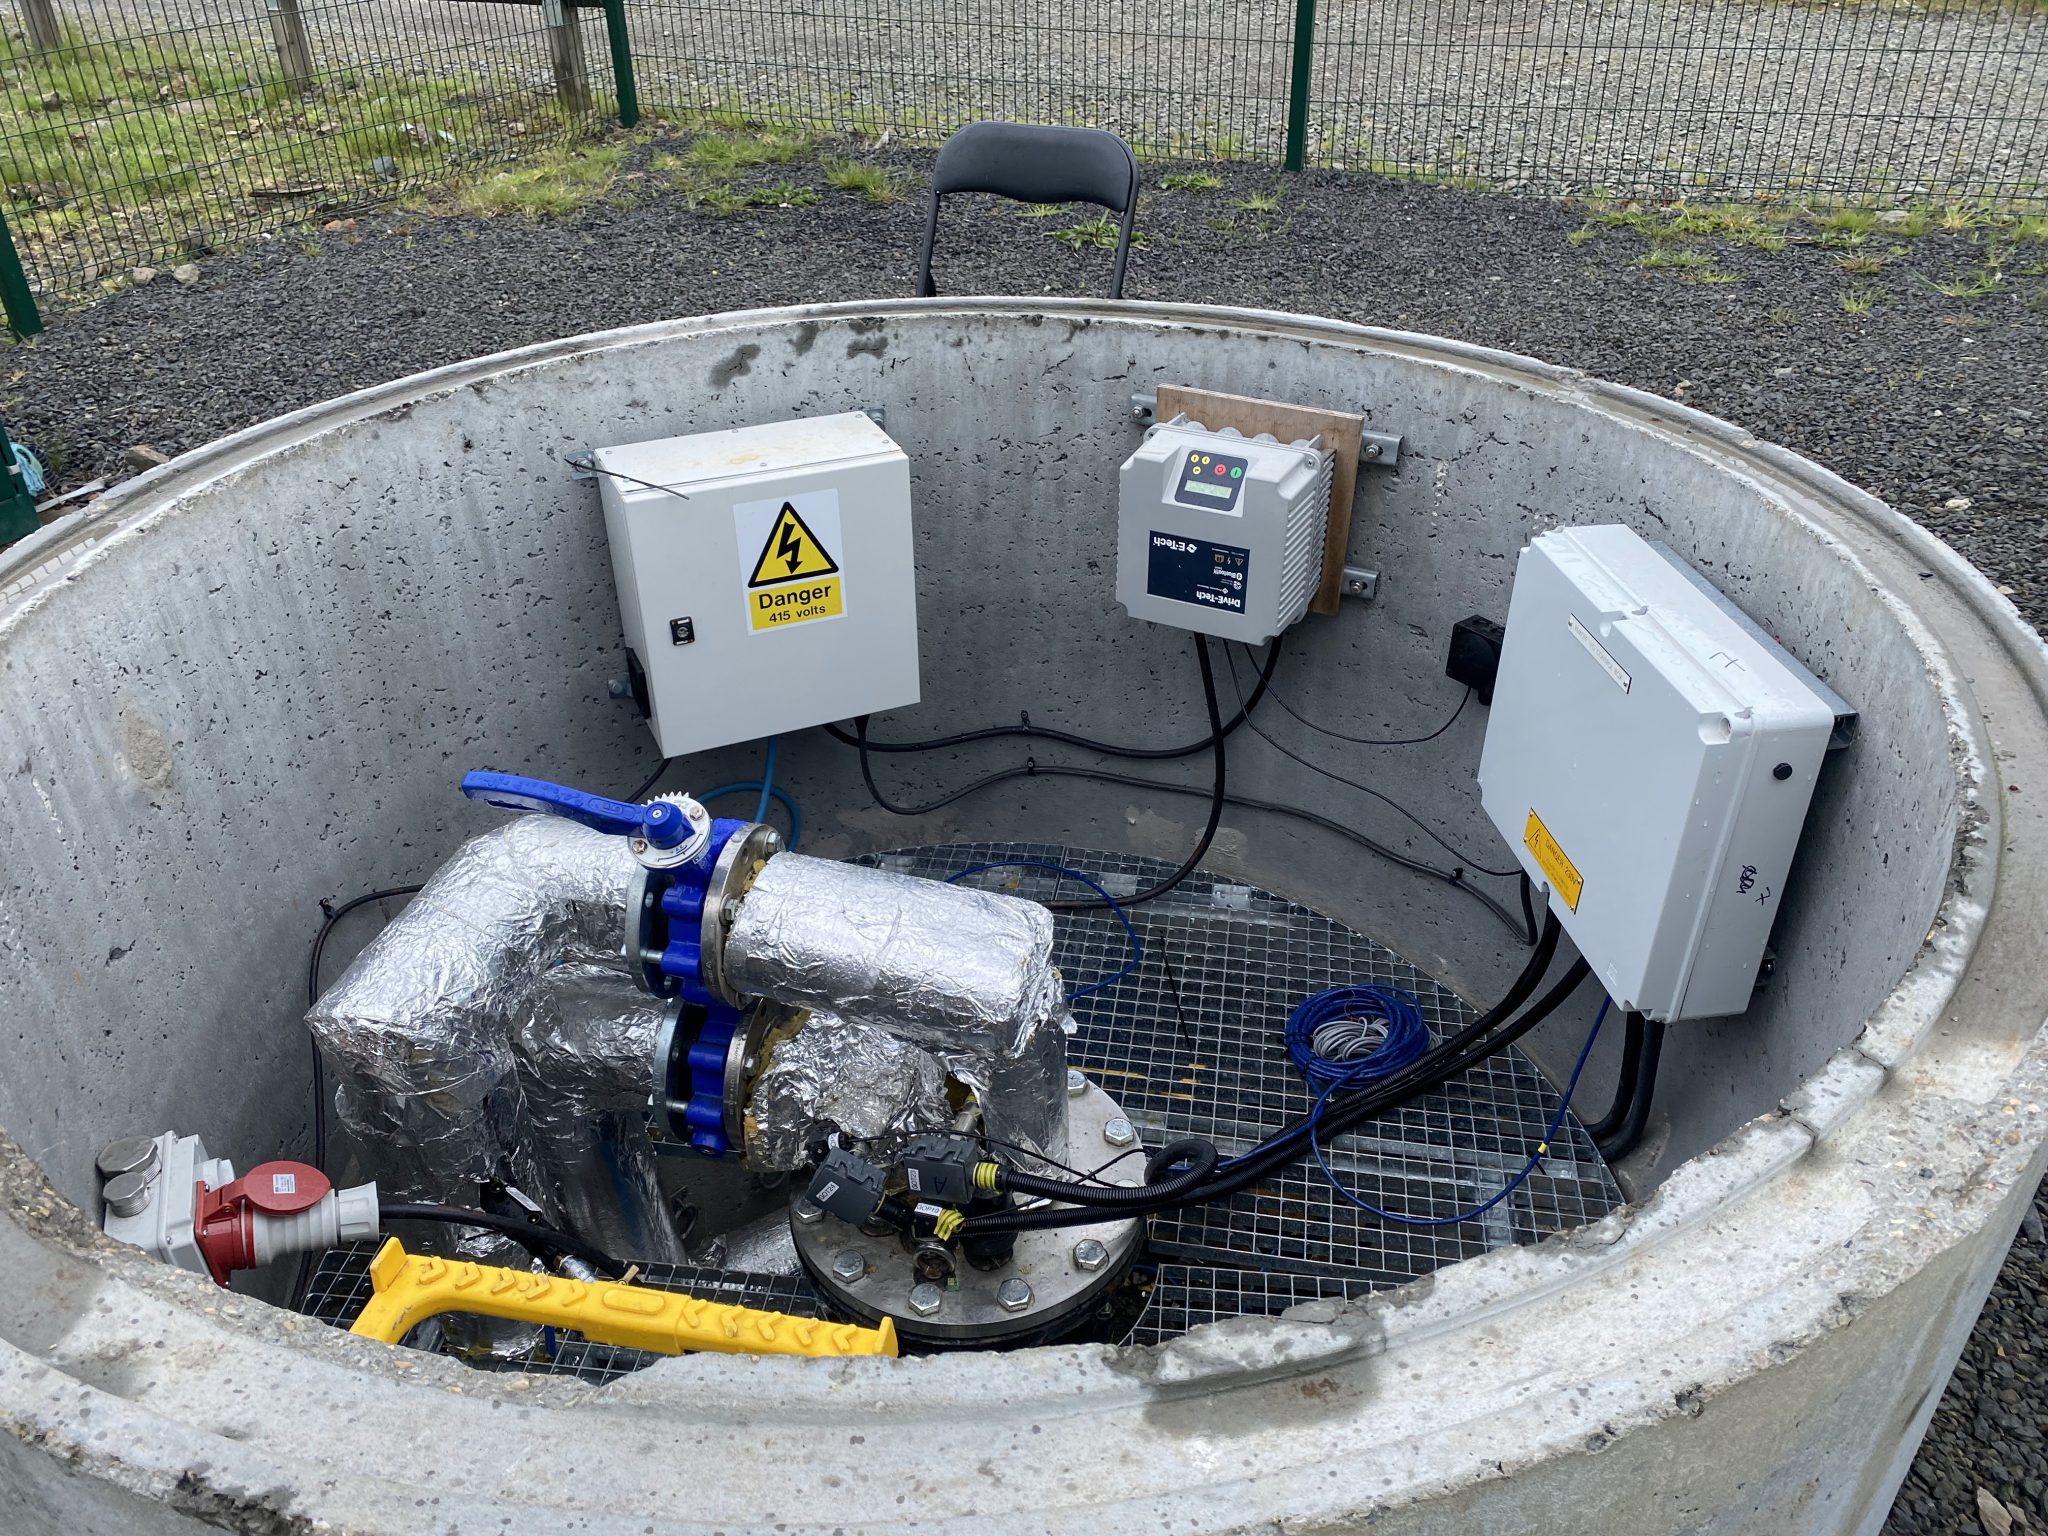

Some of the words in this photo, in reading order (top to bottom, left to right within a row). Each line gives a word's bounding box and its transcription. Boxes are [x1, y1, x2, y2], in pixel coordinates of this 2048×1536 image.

[758, 585, 831, 609] Danger
[1196, 591, 1241, 608] DrivE-Tech
[769, 610, 791, 622] 415
[796, 606, 826, 617] volts
[1545, 838, 1564, 868] DANGER
